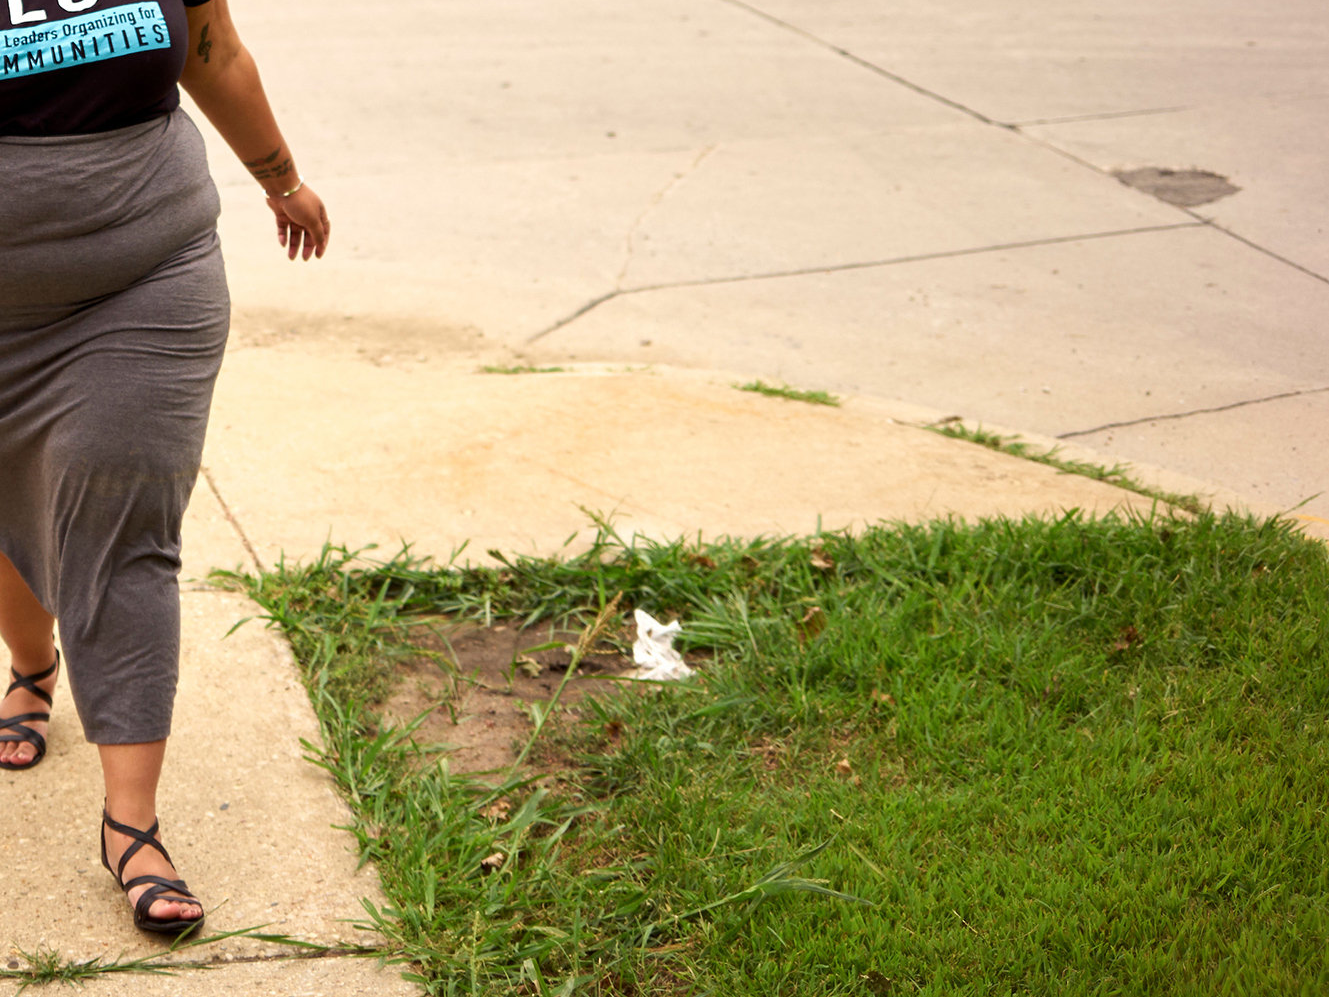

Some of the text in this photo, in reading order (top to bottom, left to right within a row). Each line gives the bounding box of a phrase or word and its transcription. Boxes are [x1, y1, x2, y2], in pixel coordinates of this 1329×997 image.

[4, 28, 58, 47] Leaders
[62, 13, 136, 37] Organizing
[138, 7, 156, 21] for
